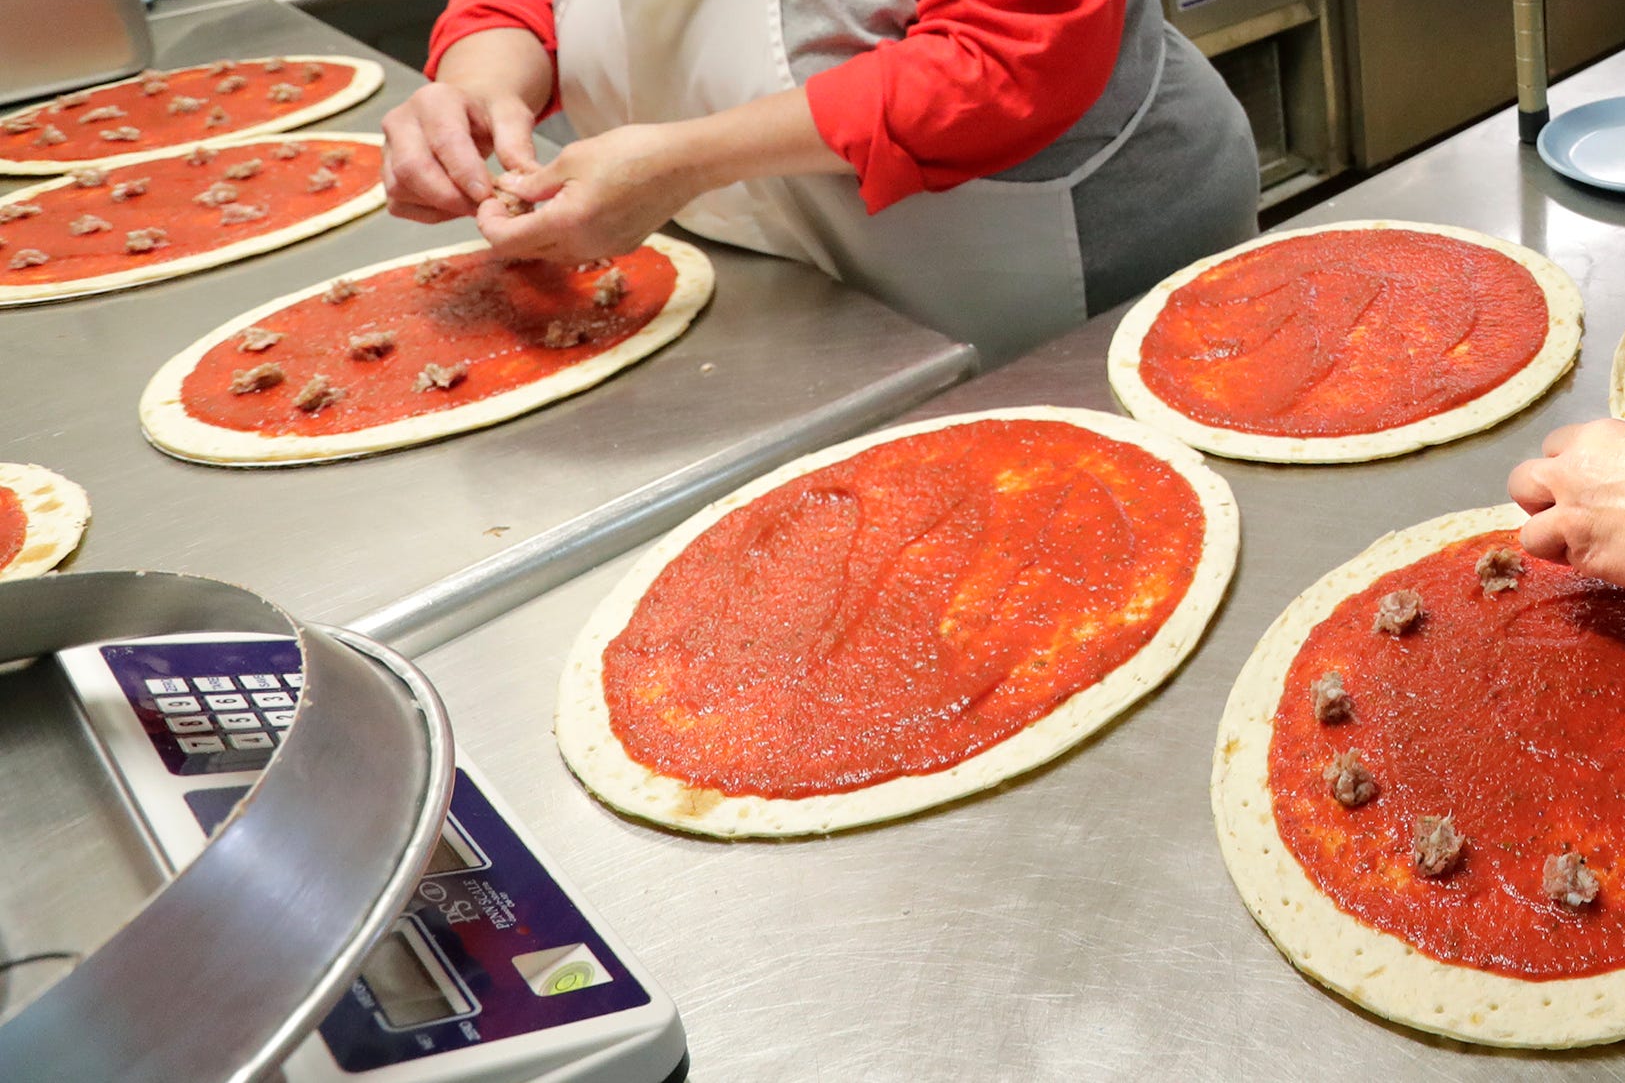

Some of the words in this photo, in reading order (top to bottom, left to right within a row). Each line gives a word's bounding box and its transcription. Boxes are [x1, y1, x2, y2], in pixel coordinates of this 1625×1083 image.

[168, 699, 191, 708] 9
[215, 697, 237, 705] 6
[179, 719, 203, 727] 8
[229, 717, 250, 725] 5
[241, 736, 264, 744] 4
[463, 879, 492, 906] SCALE
[482, 906, 510, 930] PENN
[458, 1020, 481, 1042] ZERO
